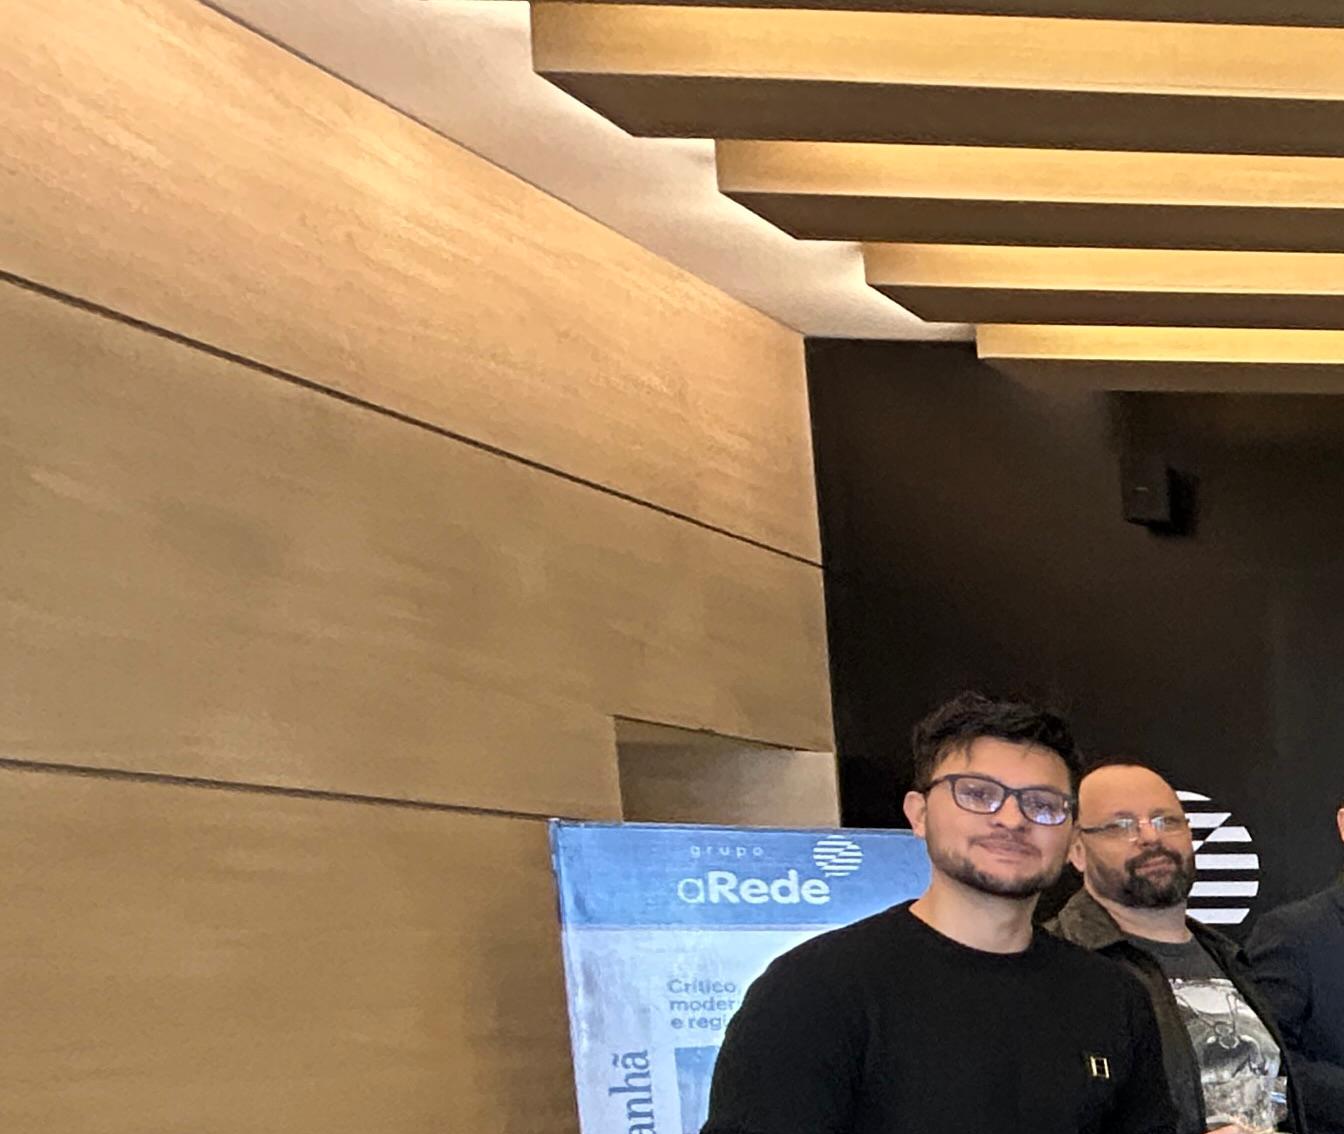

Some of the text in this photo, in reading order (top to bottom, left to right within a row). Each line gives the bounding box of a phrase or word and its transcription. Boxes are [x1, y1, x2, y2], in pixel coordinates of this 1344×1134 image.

[690, 845, 764, 858] grupo
[677, 868, 832, 906] aRede
[669, 996, 740, 1011] moder
[670, 1017, 683, 1029] e
